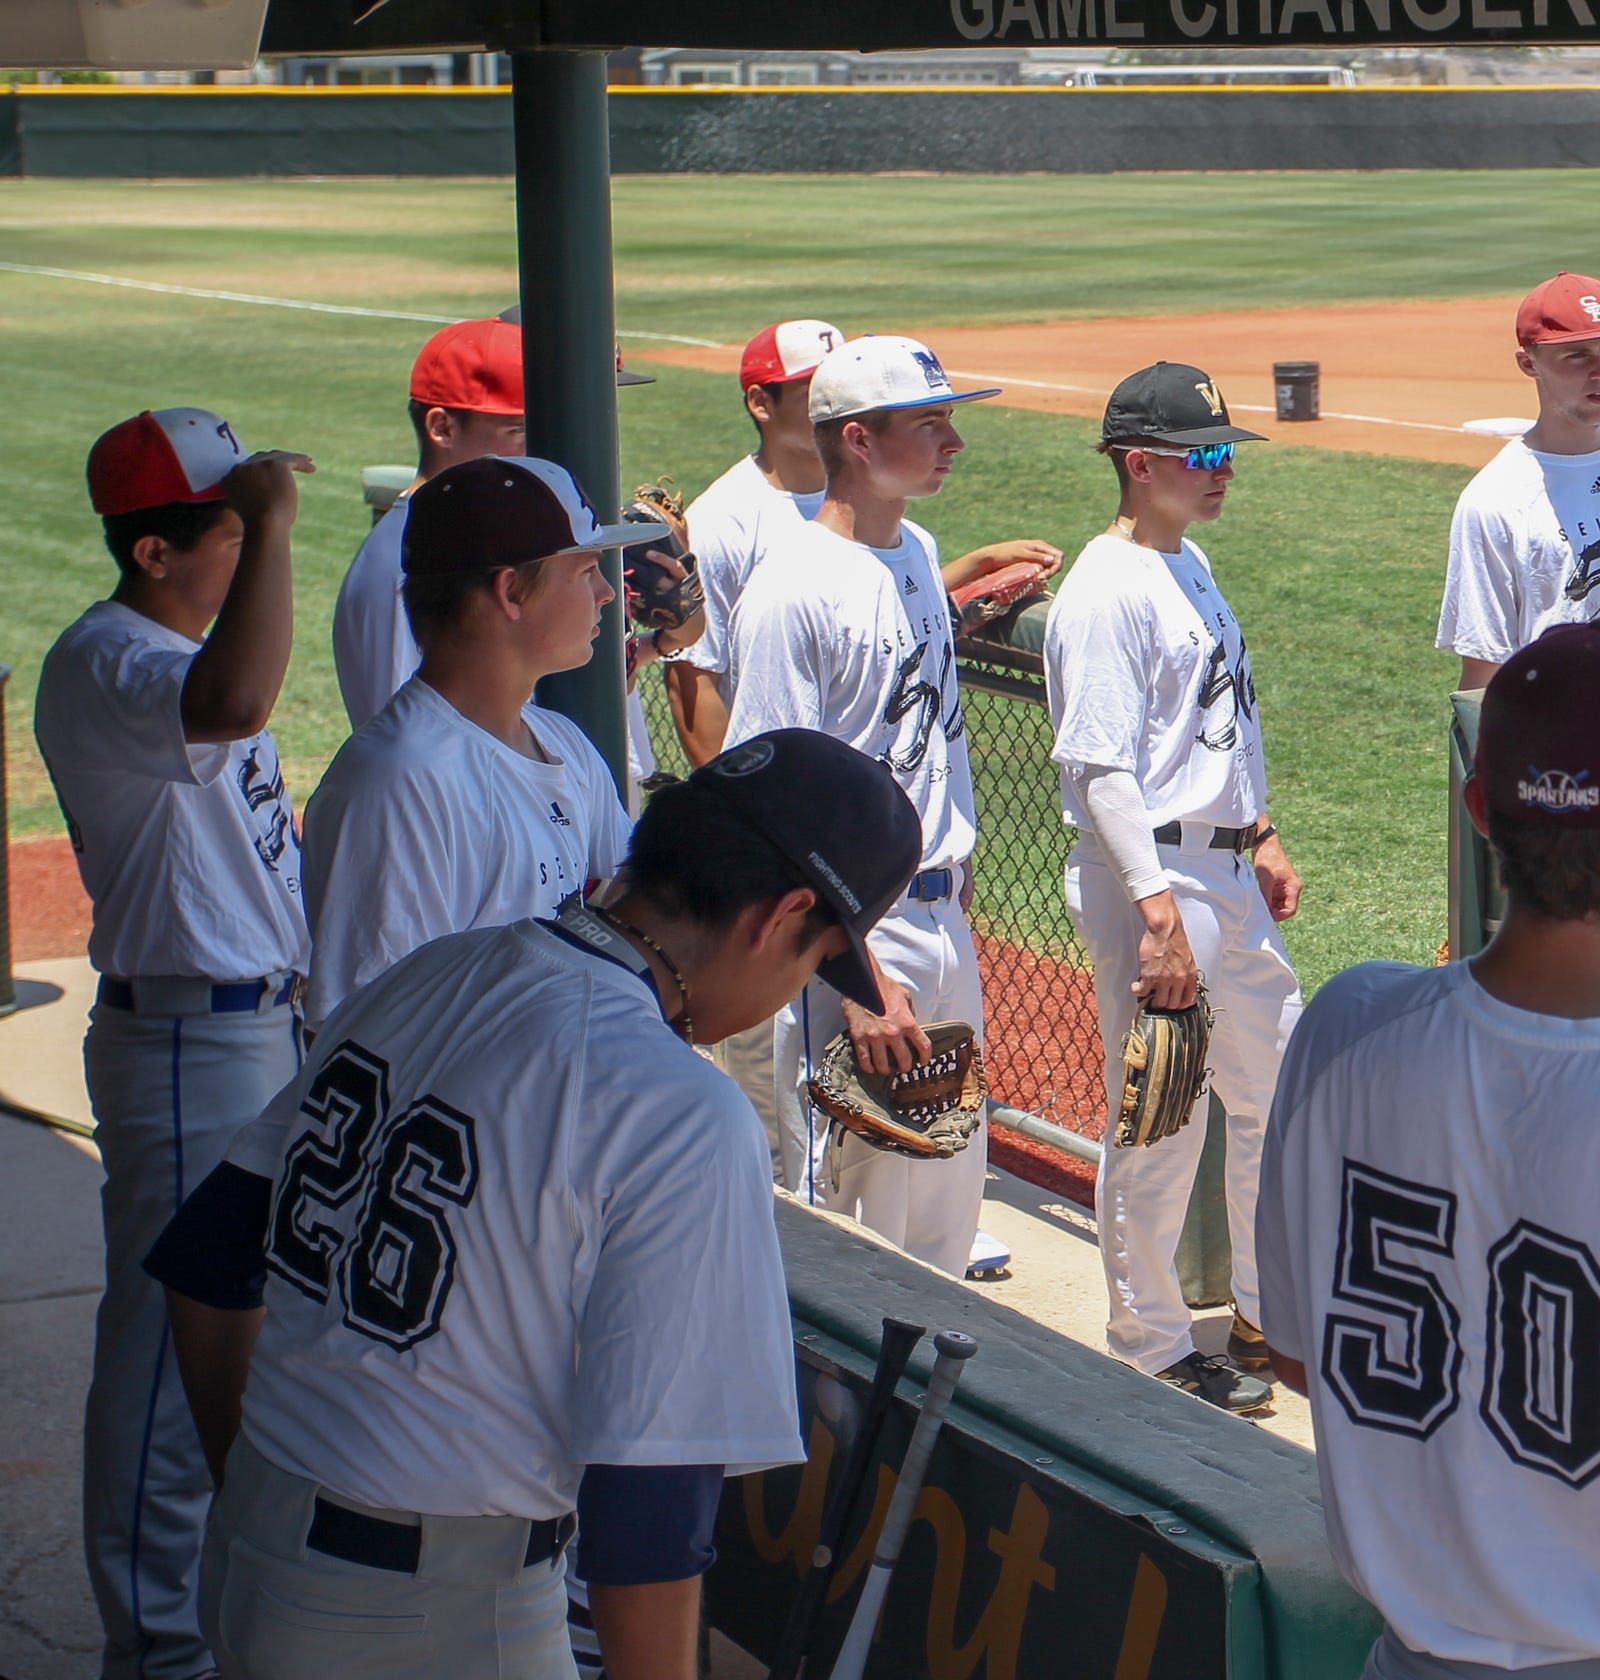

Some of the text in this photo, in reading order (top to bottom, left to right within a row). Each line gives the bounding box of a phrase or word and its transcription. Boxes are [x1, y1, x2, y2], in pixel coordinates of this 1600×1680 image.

[1195, 379, 1224, 416] V
[882, 611, 947, 655] SELEC
[1517, 780, 1600, 807] SPARTANS
[807, 851, 863, 914] FIGHTING SCOUTS
[263, 1038, 480, 1354] 26
